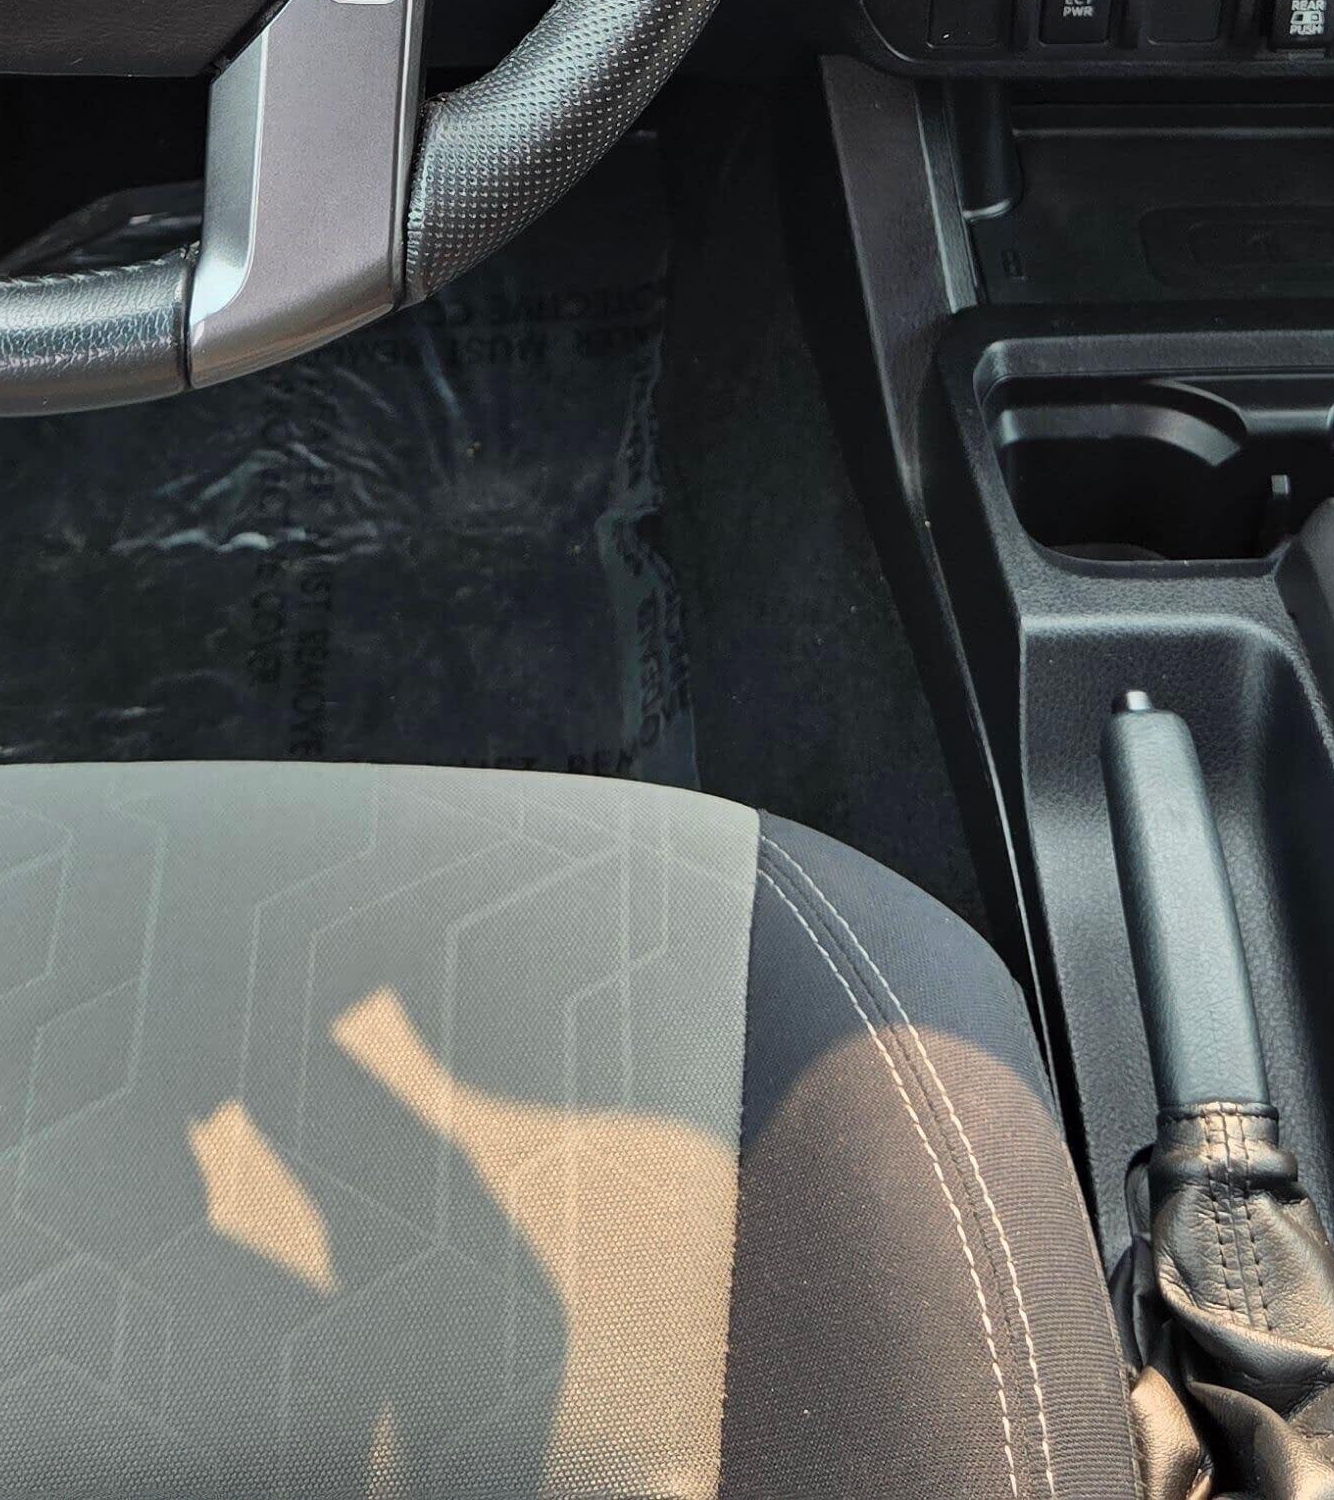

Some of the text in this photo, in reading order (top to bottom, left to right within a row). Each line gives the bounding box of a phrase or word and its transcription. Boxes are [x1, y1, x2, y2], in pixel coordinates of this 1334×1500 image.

[1063, 6, 1095, 18] PWR
[1291, 0, 1325, 12] REAR
[1289, 23, 1324, 36] PUSH
